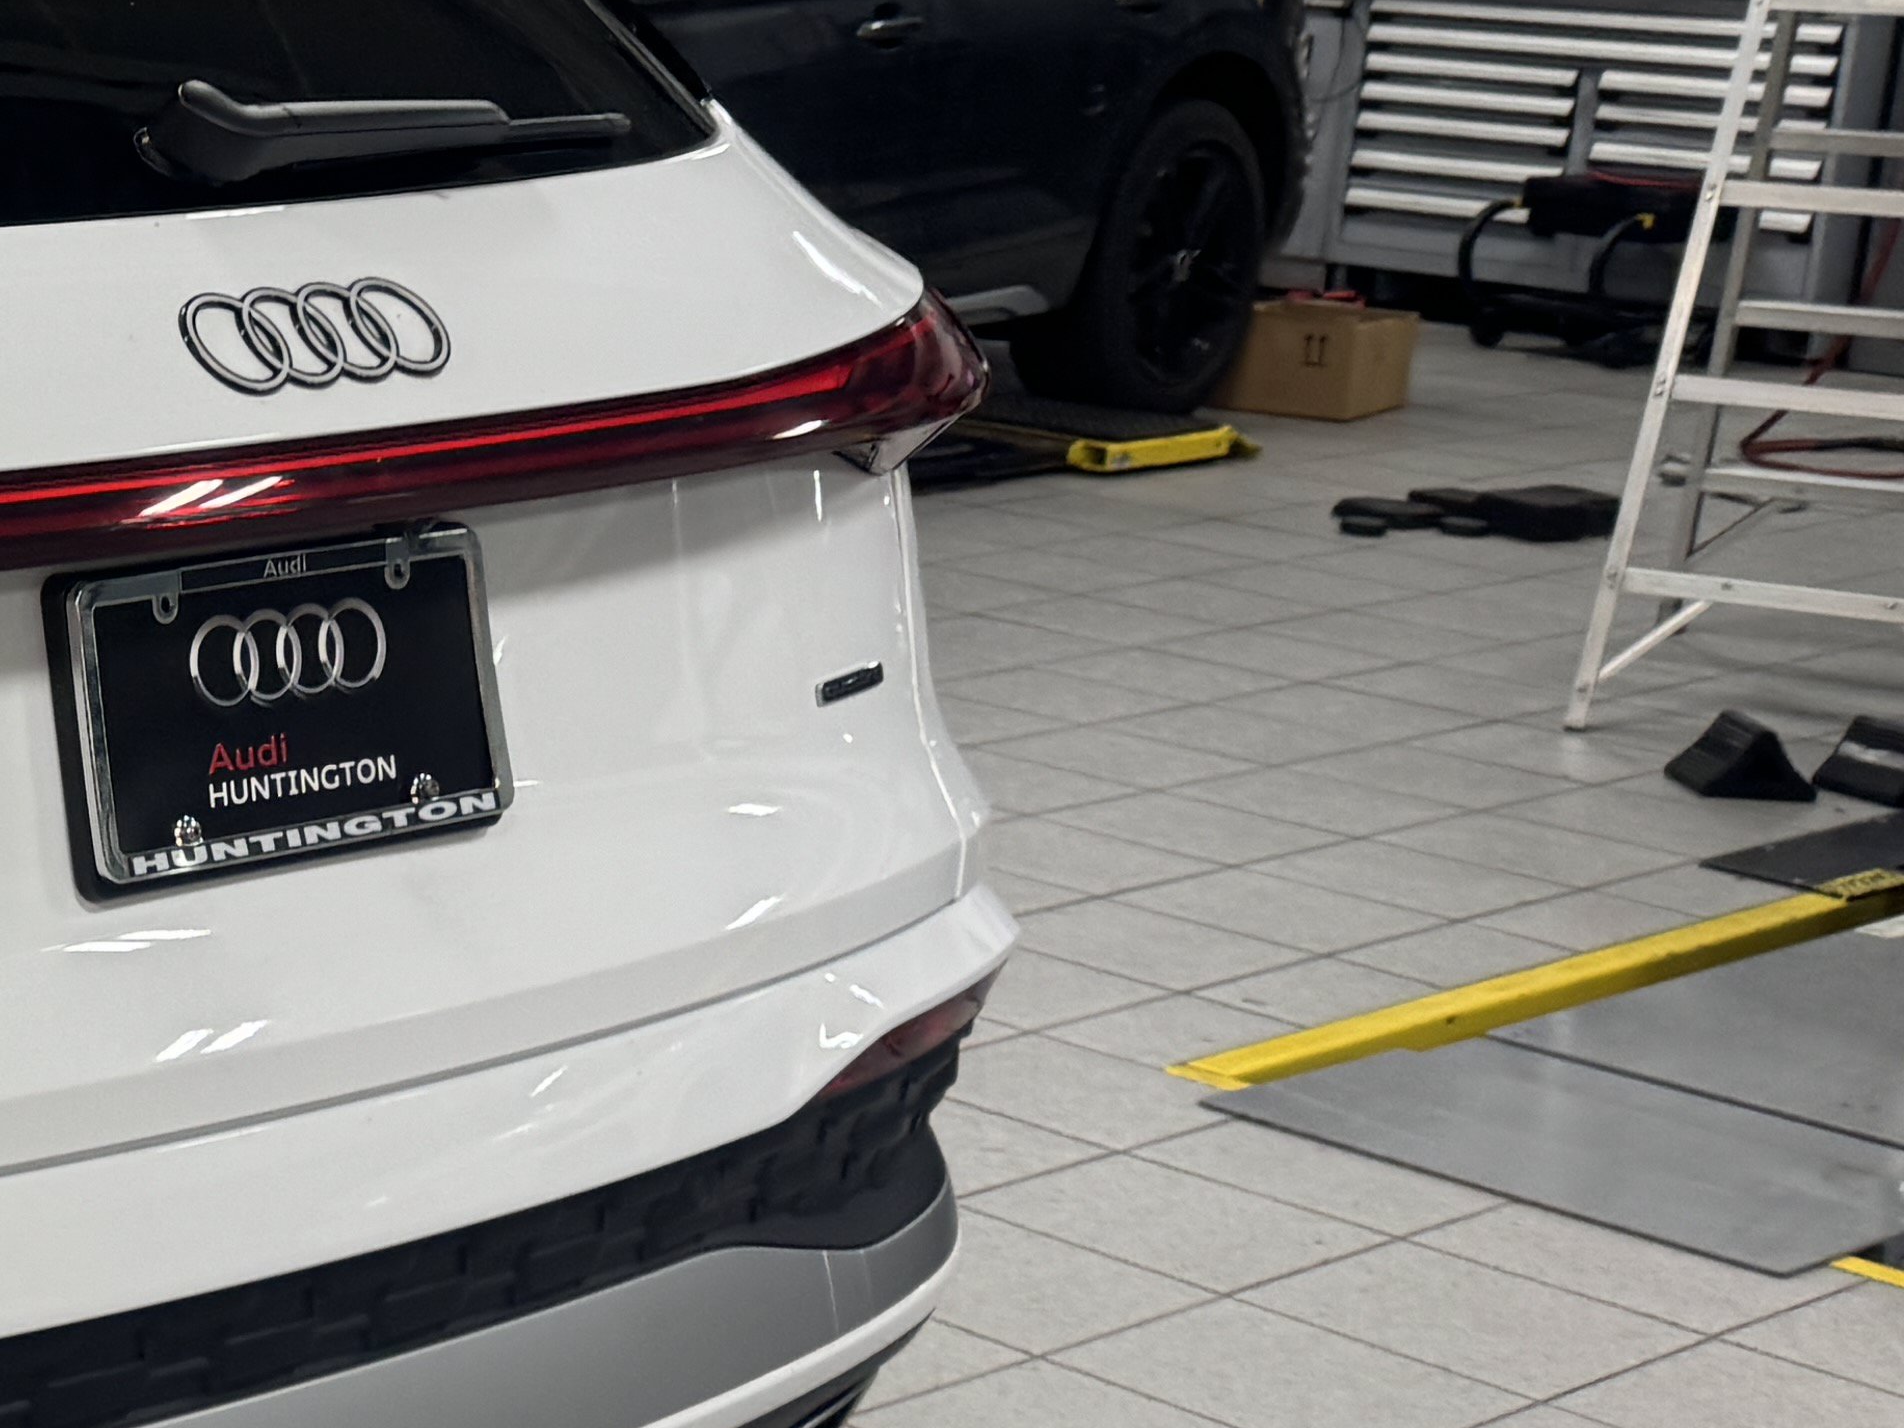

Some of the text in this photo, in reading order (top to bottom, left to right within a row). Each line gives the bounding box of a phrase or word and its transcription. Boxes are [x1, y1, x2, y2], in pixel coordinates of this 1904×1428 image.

[263, 554, 307, 579] Audi
[208, 733, 289, 774] Audi
[208, 754, 397, 809] HUNTINGTON
[132, 791, 497, 876] HUNTINGTON
